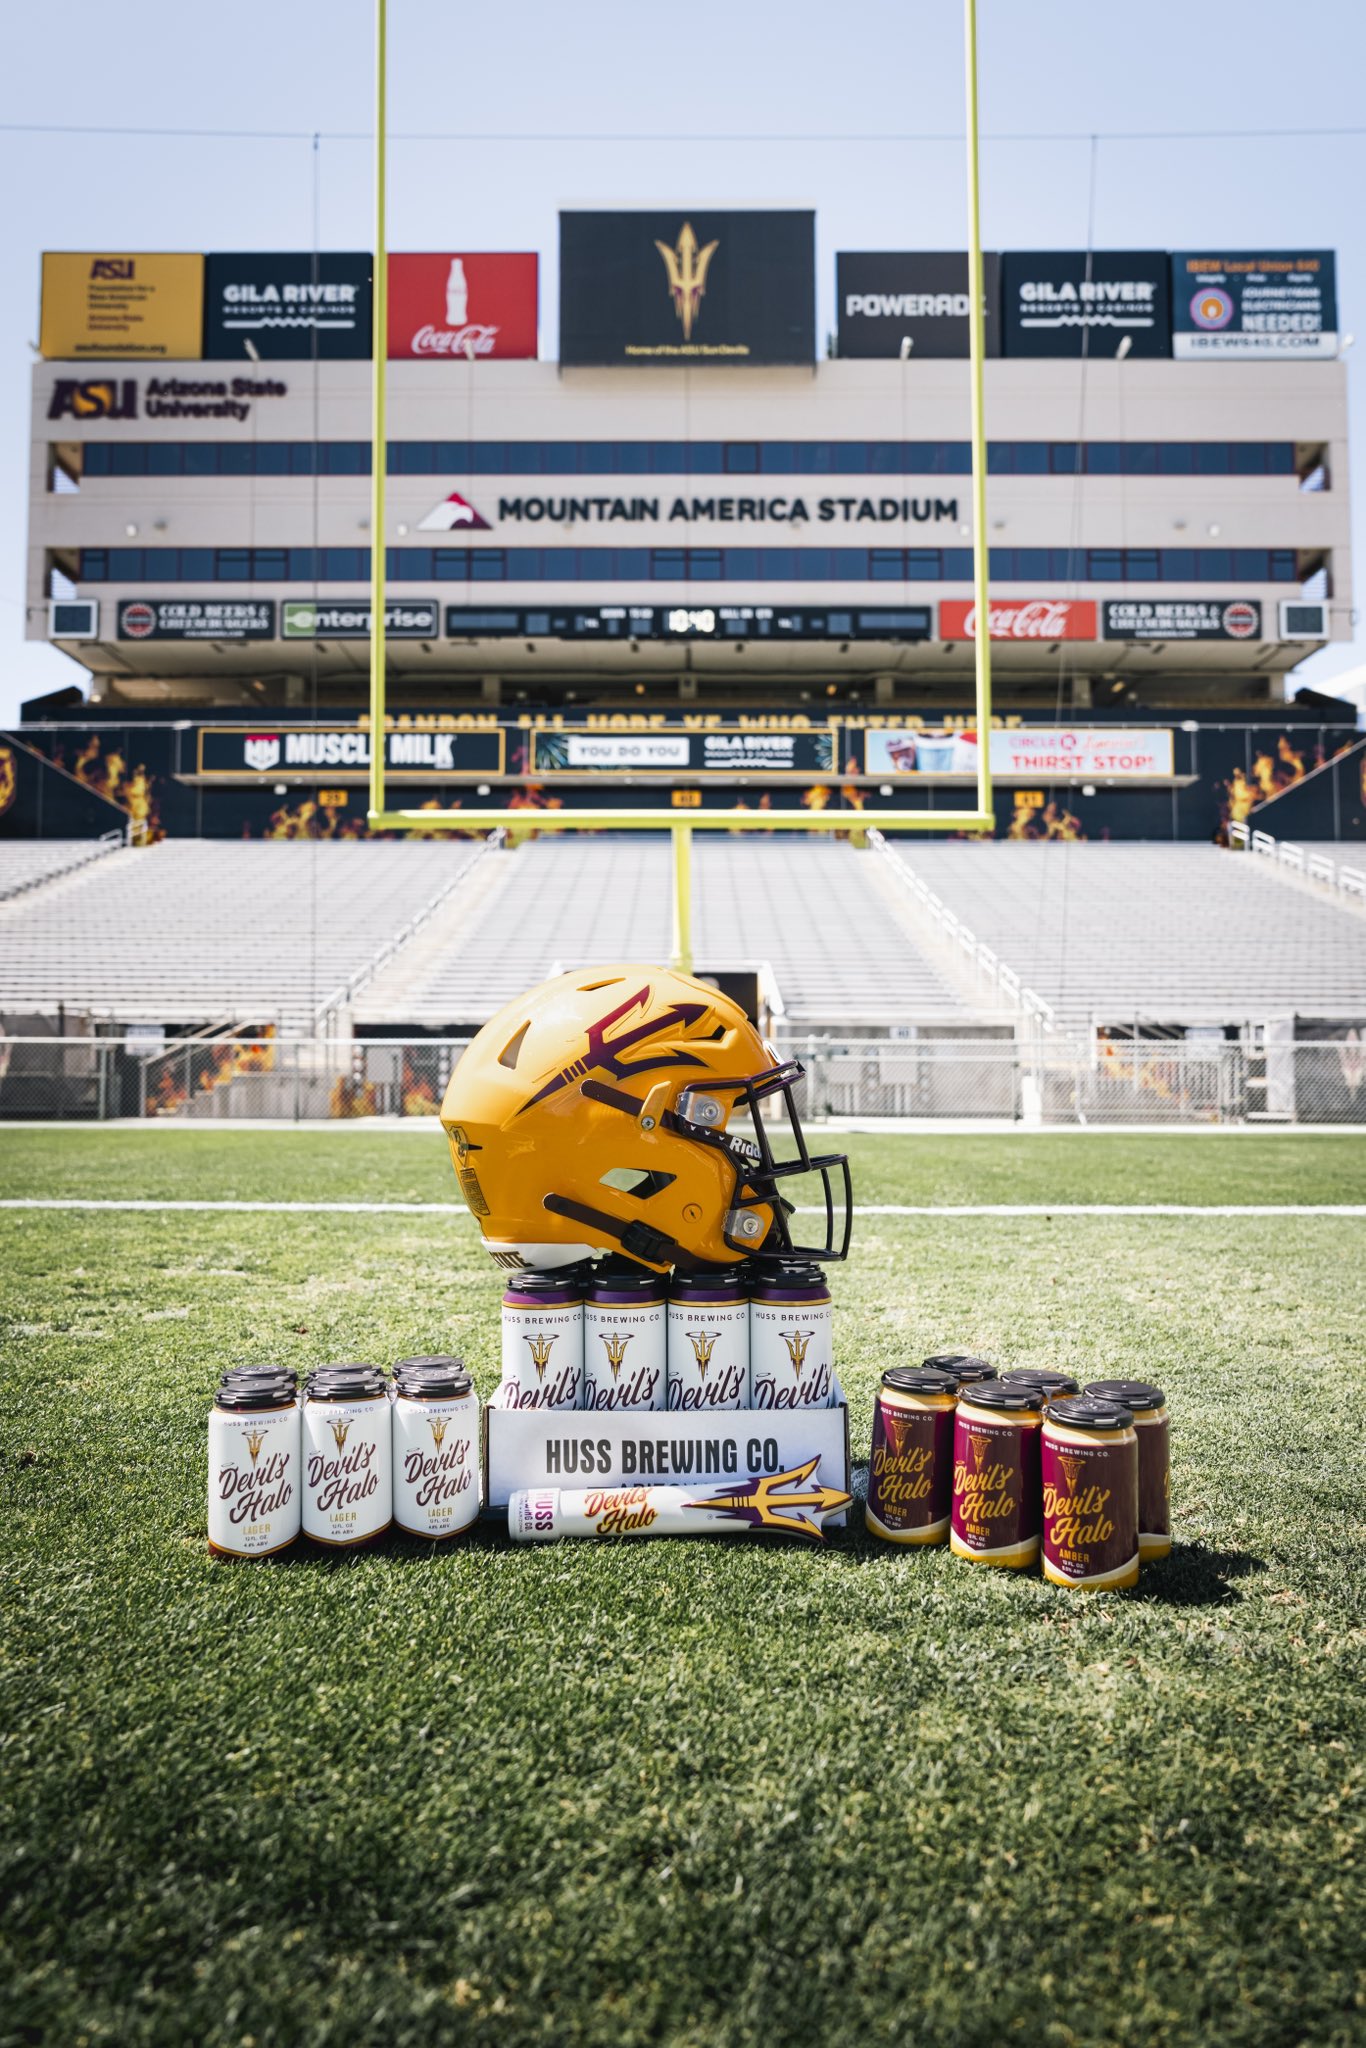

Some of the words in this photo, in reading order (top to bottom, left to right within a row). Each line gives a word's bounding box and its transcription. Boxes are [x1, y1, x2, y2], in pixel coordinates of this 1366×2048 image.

[91, 259, 135, 280] ASU
[223, 284, 280, 302] GILA
[282, 284, 356, 302] RIVER
[1020, 282, 1077, 301] GILA
[1079, 282, 1153, 301] RIVER
[846, 294, 987, 317] POWERAD
[146, 378, 228, 397] Arizona
[231, 378, 287, 397] State
[47, 379, 139, 420] ASU
[145, 400, 251, 421] University
[499, 497, 660, 523] MOUNTAIN
[669, 497, 809, 523] AMERICA
[817, 497, 958, 523] STADIUM
[158, 604, 202, 618] COLD
[963, 601, 1071, 637] Cca-Cola
[1109, 604, 1153, 618] COLD
[358, 713, 498, 728] AANDON
[285, 733, 386, 764] MUSCL
[390, 733, 456, 766] MILK
[579, 746, 607, 757] YOU
[618, 746, 641, 757] DO
[648, 746, 680, 757] YOU
[704, 736, 743, 750] GILA
[1011, 755, 1084, 769] THIRST
[729, 1136, 763, 1159] Ridd
[525, 1315, 569, 1325] BREWING
[600, 1315, 646, 1324] BREWING
[687, 1313, 733, 1322] BREWING
[755, 1311, 776, 1321] HUSS
[781, 1312, 824, 1322] BREWING
[504, 1366, 581, 1410] Devil's
[585, 1366, 660, 1411] Devil's
[668, 1364, 746, 1410] Devil's
[754, 1363, 832, 1410] Devil's
[428, 1406, 459, 1414] BREWING
[893, 1410, 920, 1421] BREWING
[244, 1418, 277, 1427] BREWING
[971, 1425, 999, 1436] BREWING
[404, 1439, 471, 1484] Devil's
[546, 1439, 611, 1474] HUSS
[621, 1438, 738, 1474] BREWING
[746, 1438, 785, 1473] CO.
[873, 1446, 933, 1477] Devil's
[1060, 1445, 1094, 1457] BREWING
[307, 1441, 376, 1488] Devil's
[218, 1452, 290, 1500] Devil's
[416, 1466, 472, 1507] Halo
[954, 1463, 1014, 1496] Devil's
[317, 1468, 380, 1512] Halo
[877, 1473, 934, 1503] Halo
[229, 1478, 294, 1524] Halo
[524, 1497, 533, 1520] WING
[585, 1487, 654, 1518] Devil's
[883, 1503, 908, 1517] AMBER
[959, 1490, 1016, 1522] Halo
[1043, 1485, 1111, 1519] Devil's
[329, 1512, 357, 1523] LAGER
[427, 1507, 453, 1518] LAGER
[596, 1503, 658, 1534] Halo
[242, 1523, 271, 1536] LAGER
[965, 1523, 990, 1537] AMBER
[1050, 1513, 1115, 1548] Halo
[1059, 1548, 1089, 1563] AMBER
